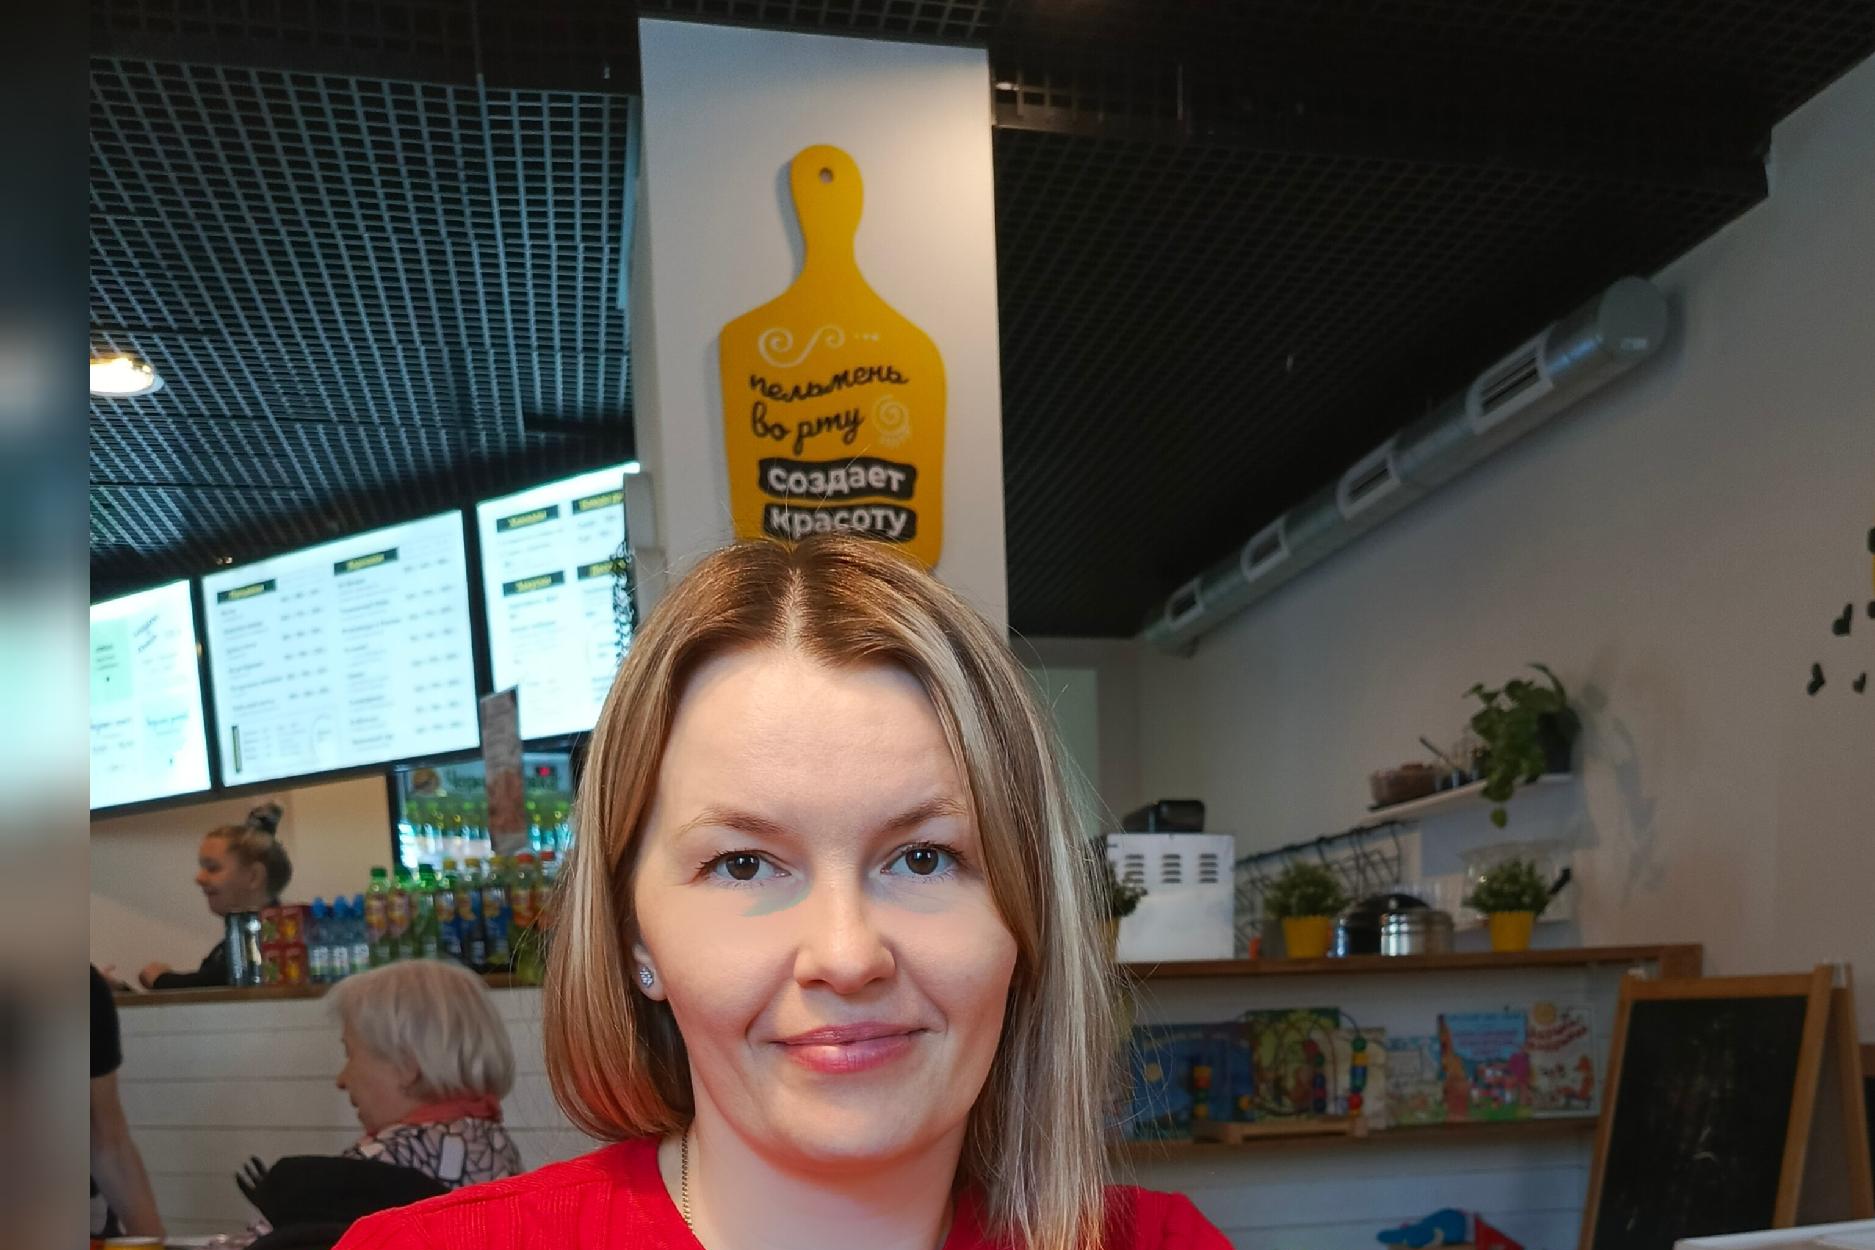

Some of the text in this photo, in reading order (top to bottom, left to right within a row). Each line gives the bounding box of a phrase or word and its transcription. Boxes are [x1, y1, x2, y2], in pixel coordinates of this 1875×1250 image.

[750, 365, 909, 402] пельмень
[752, 400, 865, 456] во рту
[767, 465, 906, 497] создает
[769, 506, 907, 539] красоту
